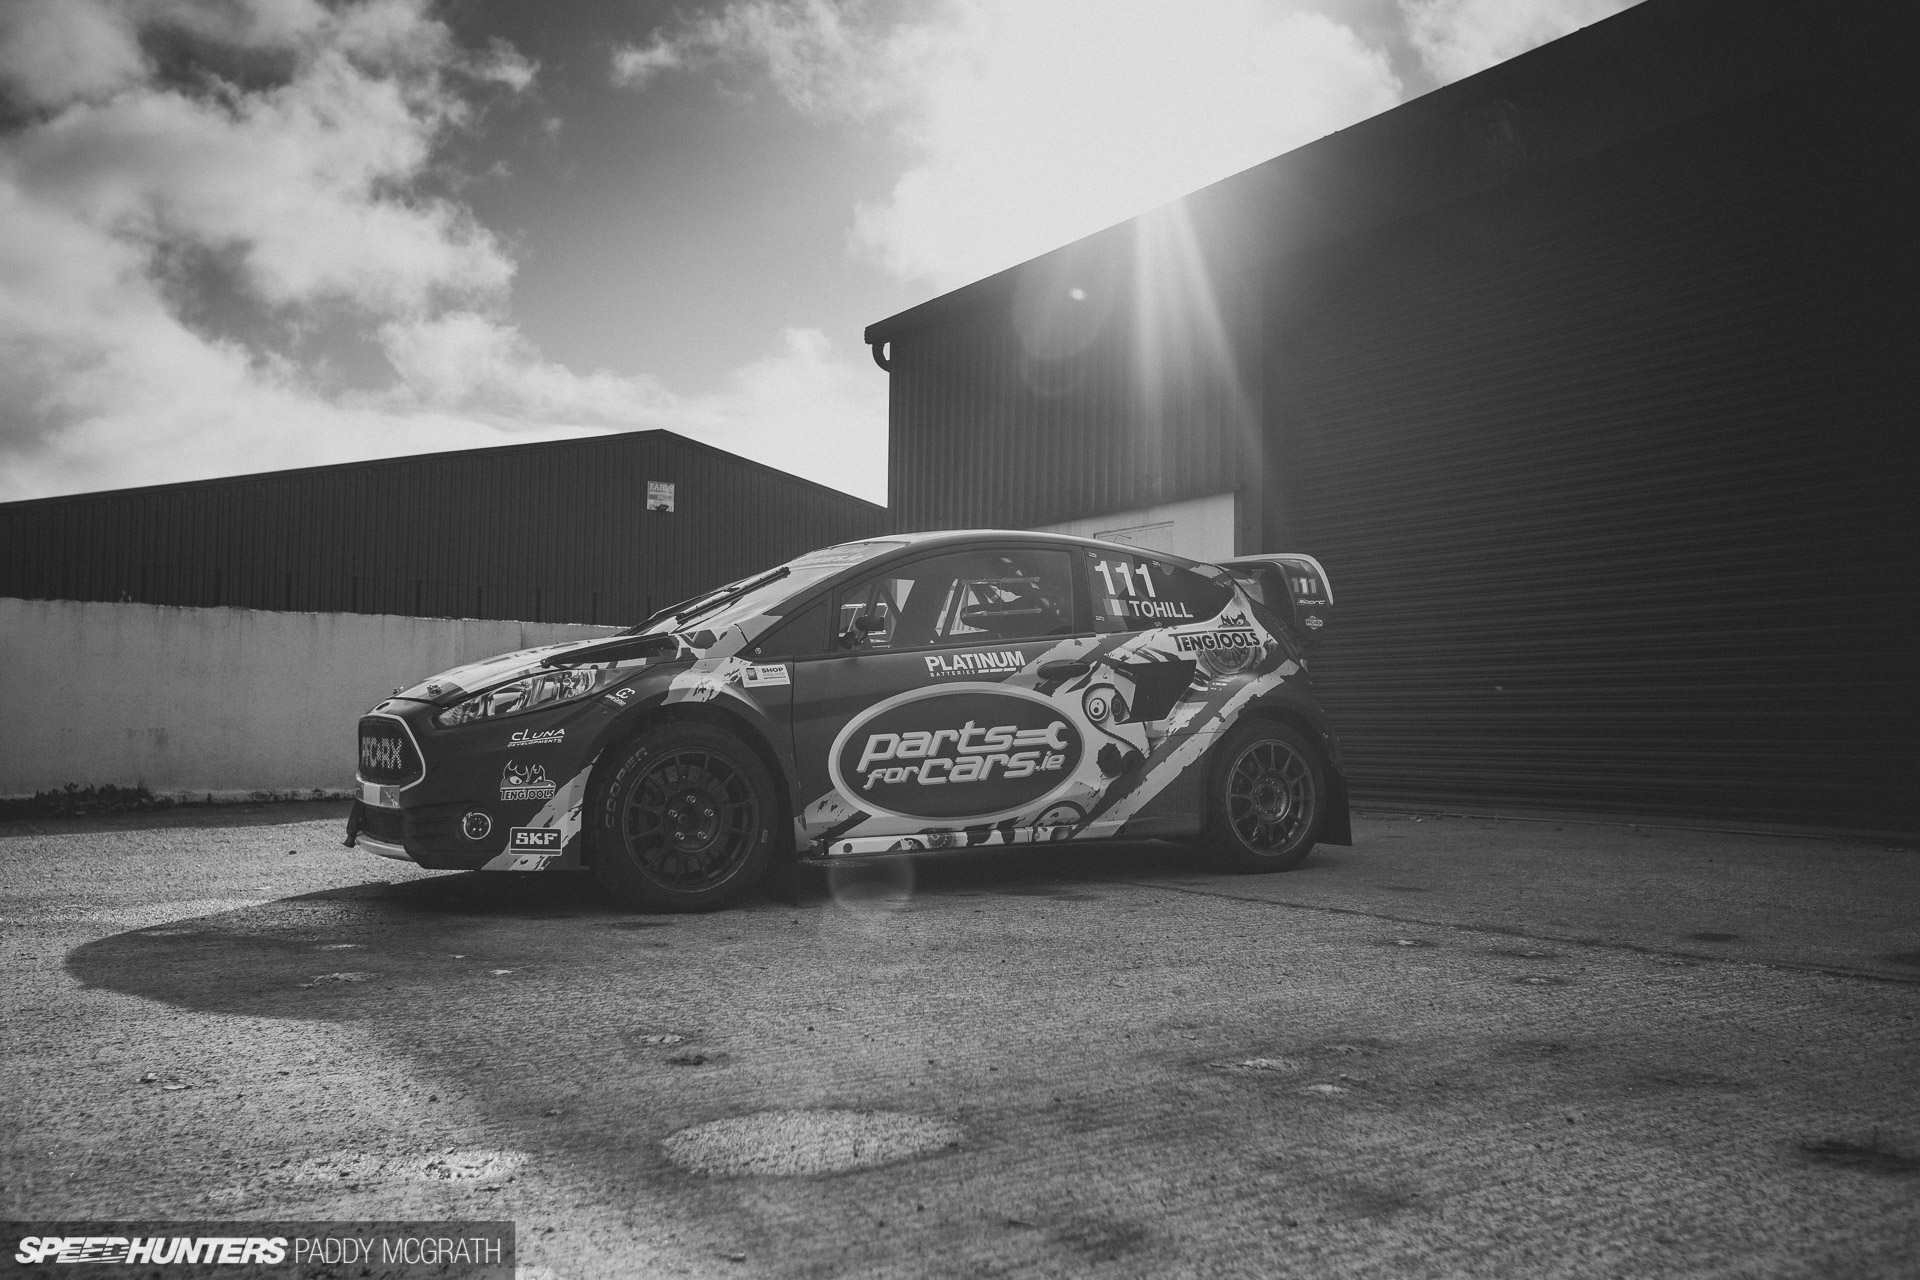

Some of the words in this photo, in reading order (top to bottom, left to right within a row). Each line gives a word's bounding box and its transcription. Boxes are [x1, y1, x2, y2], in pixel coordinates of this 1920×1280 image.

[1094, 560, 1156, 598] 111
[1291, 577, 1317, 595] 111
[1129, 600, 1194, 618] TOHILL
[924, 650, 1026, 672] PLATINUM
[930, 669, 976, 678] BATTERIES
[511, 728, 565, 741] CLUNA
[856, 720, 1018, 773] parts
[515, 832, 558, 845] SKF
